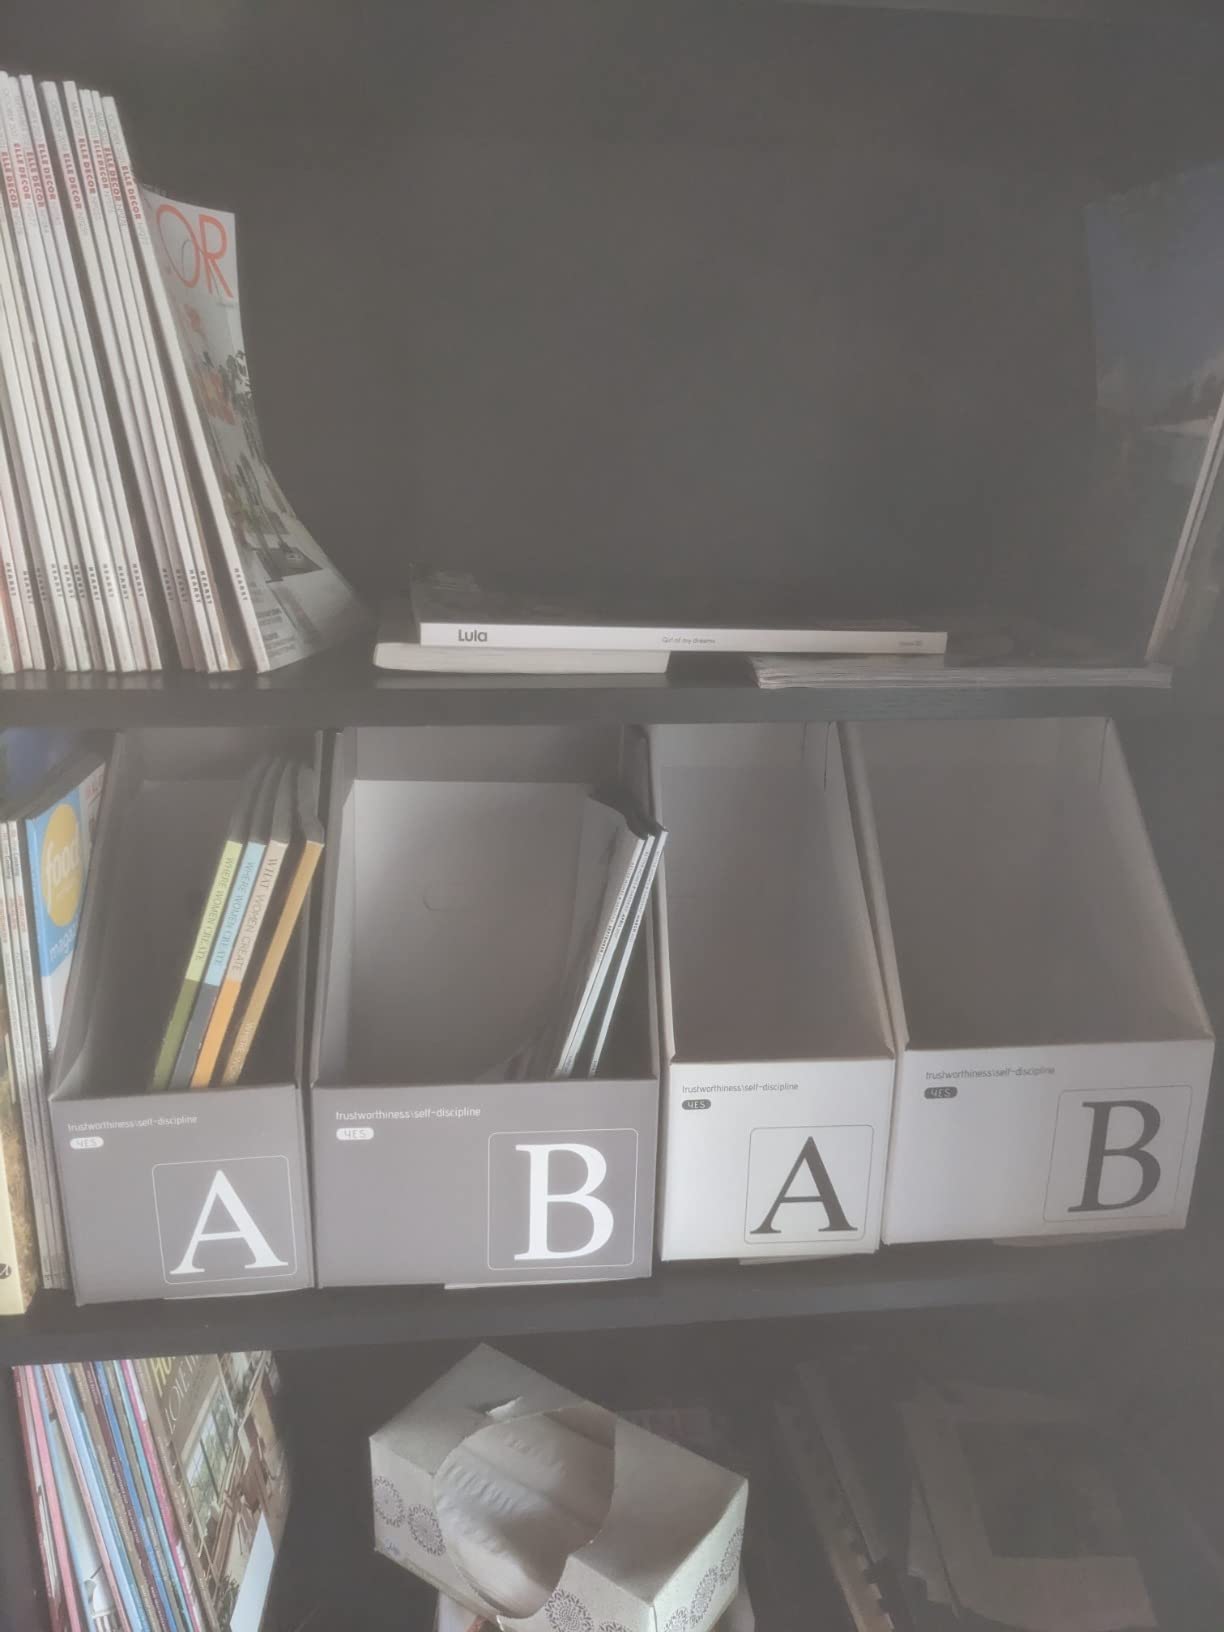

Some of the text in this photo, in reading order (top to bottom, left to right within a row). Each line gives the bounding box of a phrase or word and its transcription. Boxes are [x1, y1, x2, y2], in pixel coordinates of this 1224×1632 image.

[18, 166, 30, 199] DECOR
[43, 167, 56, 200] DECOR
[82, 161, 95, 194] DECOR
[97, 159, 109, 189] DECOR
[108, 169, 121, 201] DECOR
[5, 174, 18, 208] DECOR
[31, 174, 44, 208] DECOR
[68, 176, 81, 209] DECOR
[127, 187, 141, 220] DECOR
[457, 628, 488, 644] Lula
[687, 1101, 706, 1109] YES
[344, 1130, 366, 1139] YES
[1066, 1098, 1162, 1214] B
[749, 1135, 859, 1235] A
[513, 1143, 615, 1262] B
[169, 1168, 289, 1276] A
